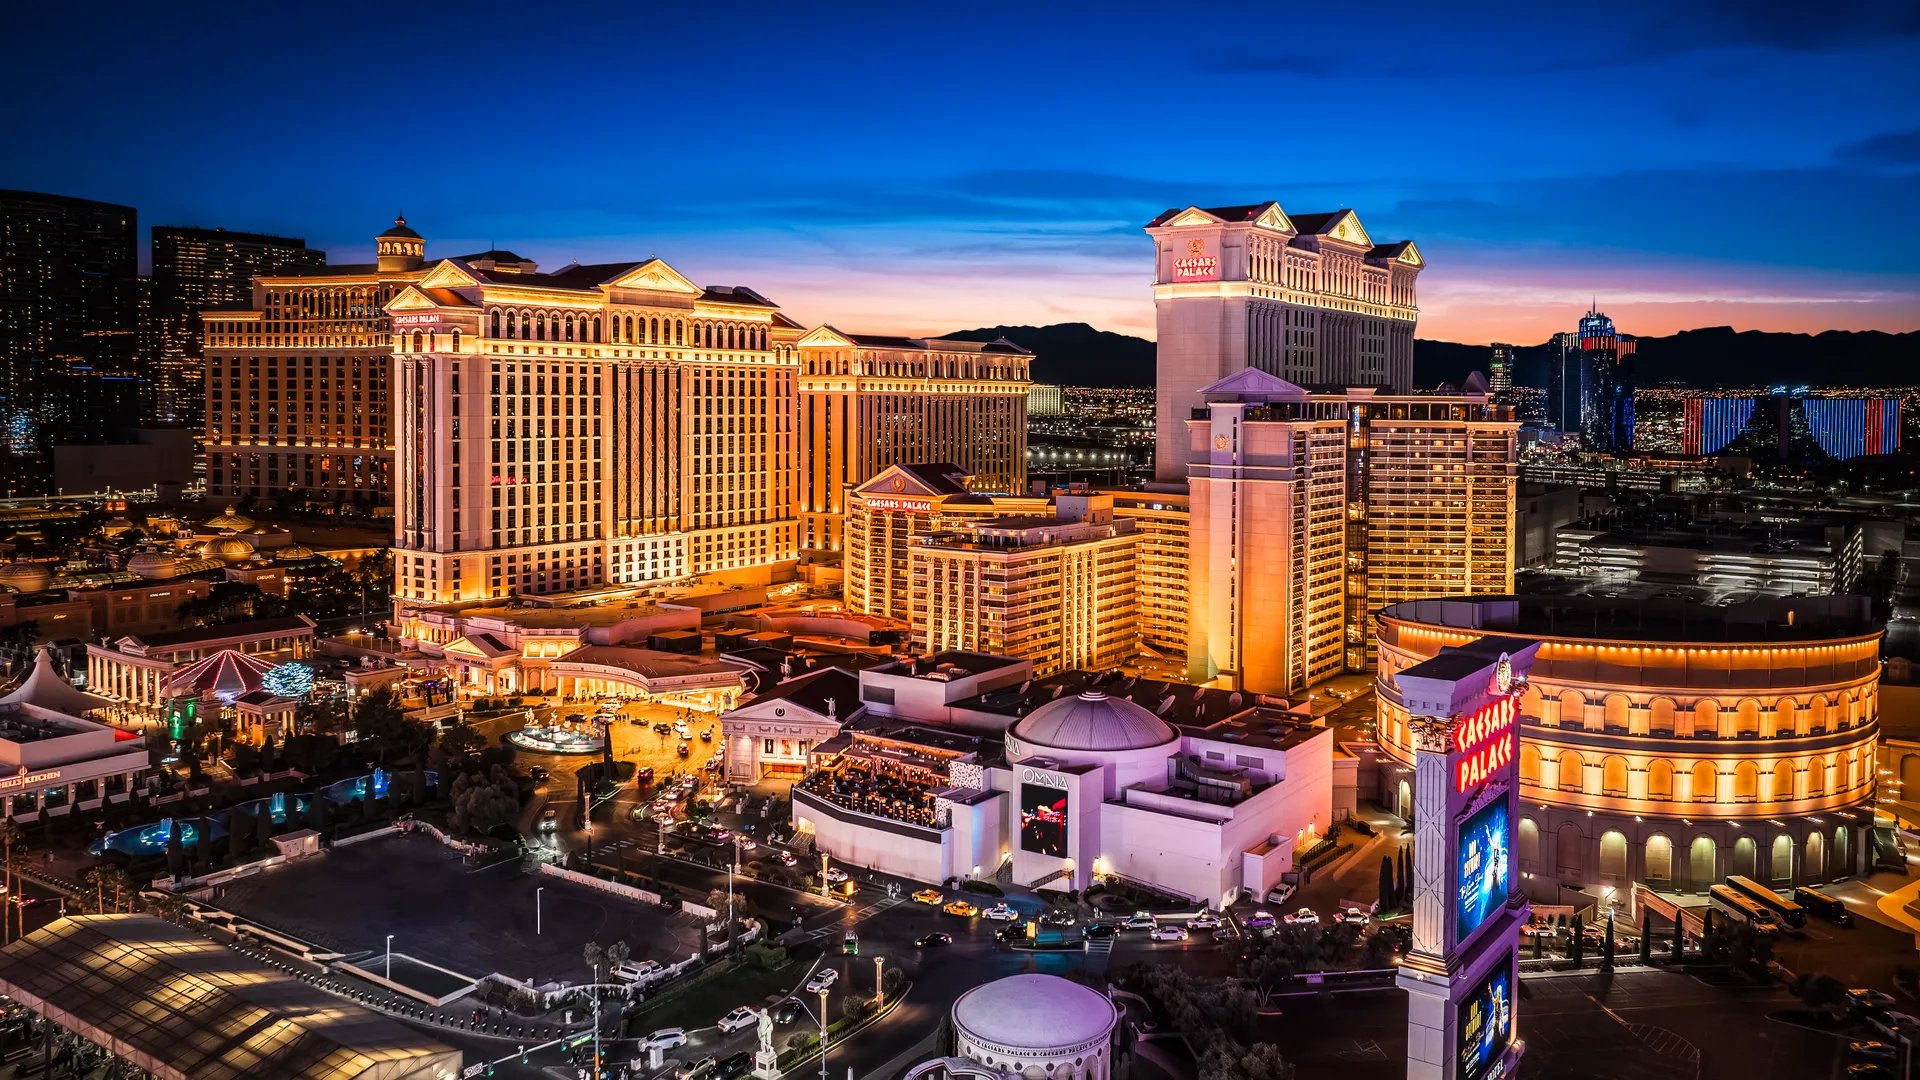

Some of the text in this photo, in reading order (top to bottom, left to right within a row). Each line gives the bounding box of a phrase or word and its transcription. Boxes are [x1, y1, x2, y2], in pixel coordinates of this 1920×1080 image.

[1175, 257, 1217, 268] CAESARS
[1177, 267, 1215, 277] PALACE
[867, 499, 931, 511] CAESARS PALACE
[1457, 694, 1515, 753] CAESARS
[1005, 734, 1021, 756] NIA
[1461, 731, 1512, 793] PALACE
[24, 770, 61, 784] KITCHEN
[1022, 767, 1069, 790] OMNIA
[1007, 1049, 1030, 1057] PALACE
[1039, 1049, 1066, 1057] CAESARS
